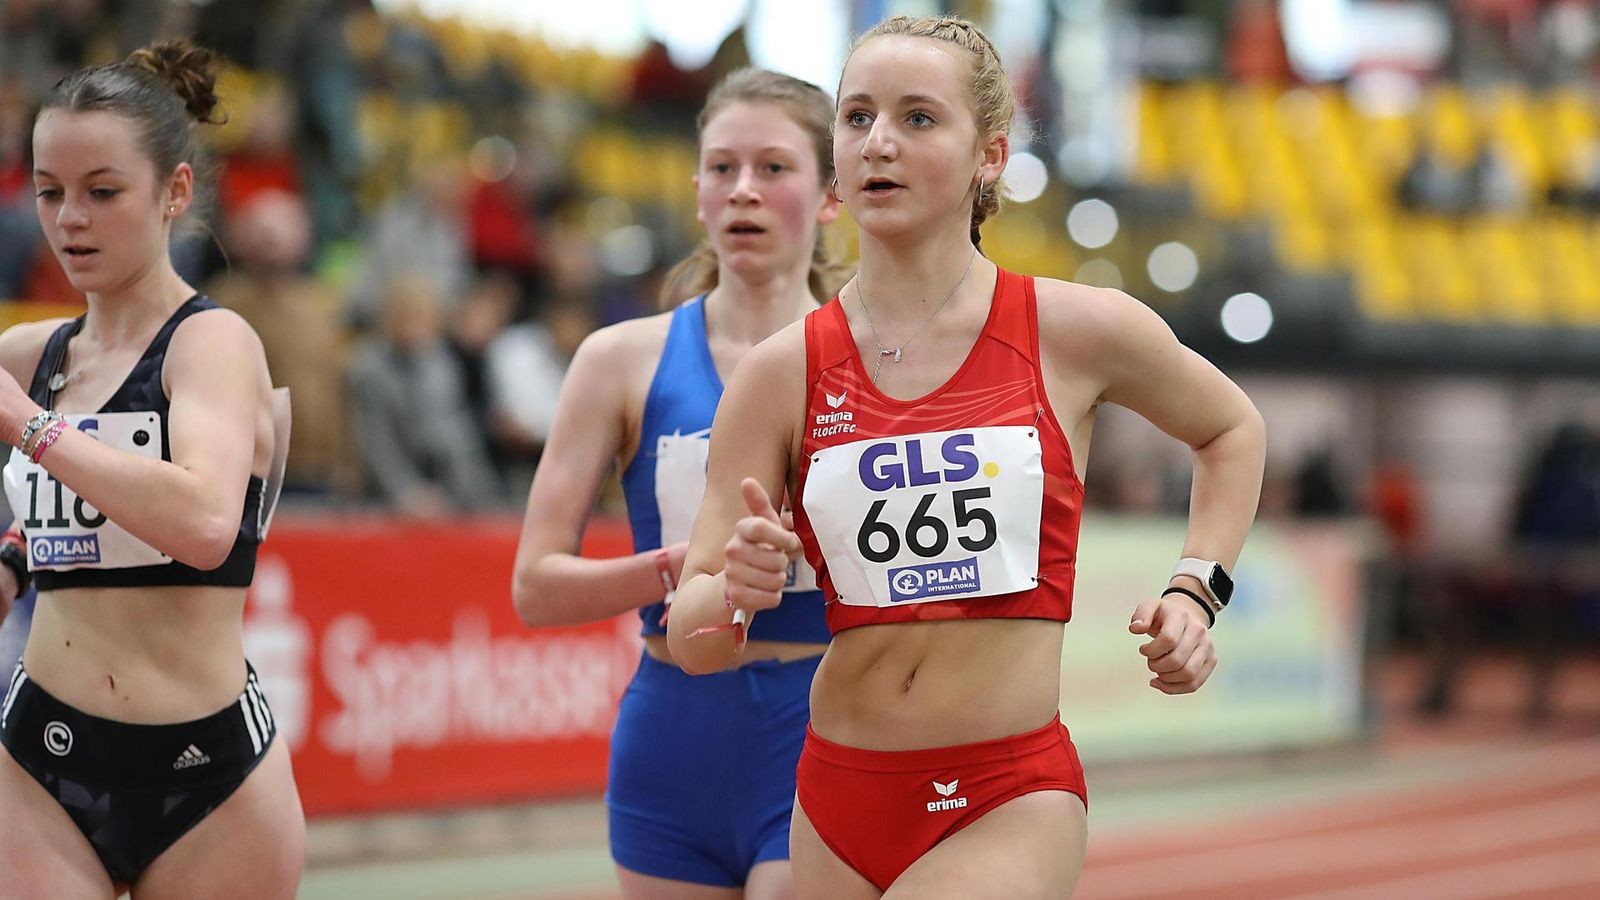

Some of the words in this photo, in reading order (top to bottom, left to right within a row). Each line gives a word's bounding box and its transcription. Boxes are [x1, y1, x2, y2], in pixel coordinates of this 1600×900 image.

[816, 411, 853, 425] erima
[812, 423, 857, 439] FLOCKTEC
[856, 486, 997, 563] 665
[54, 539, 96, 555] PLAN
[925, 565, 976, 585] PLAN
[927, 582, 977, 593] INTERNATIONAL
[926, 797, 968, 812] erima
